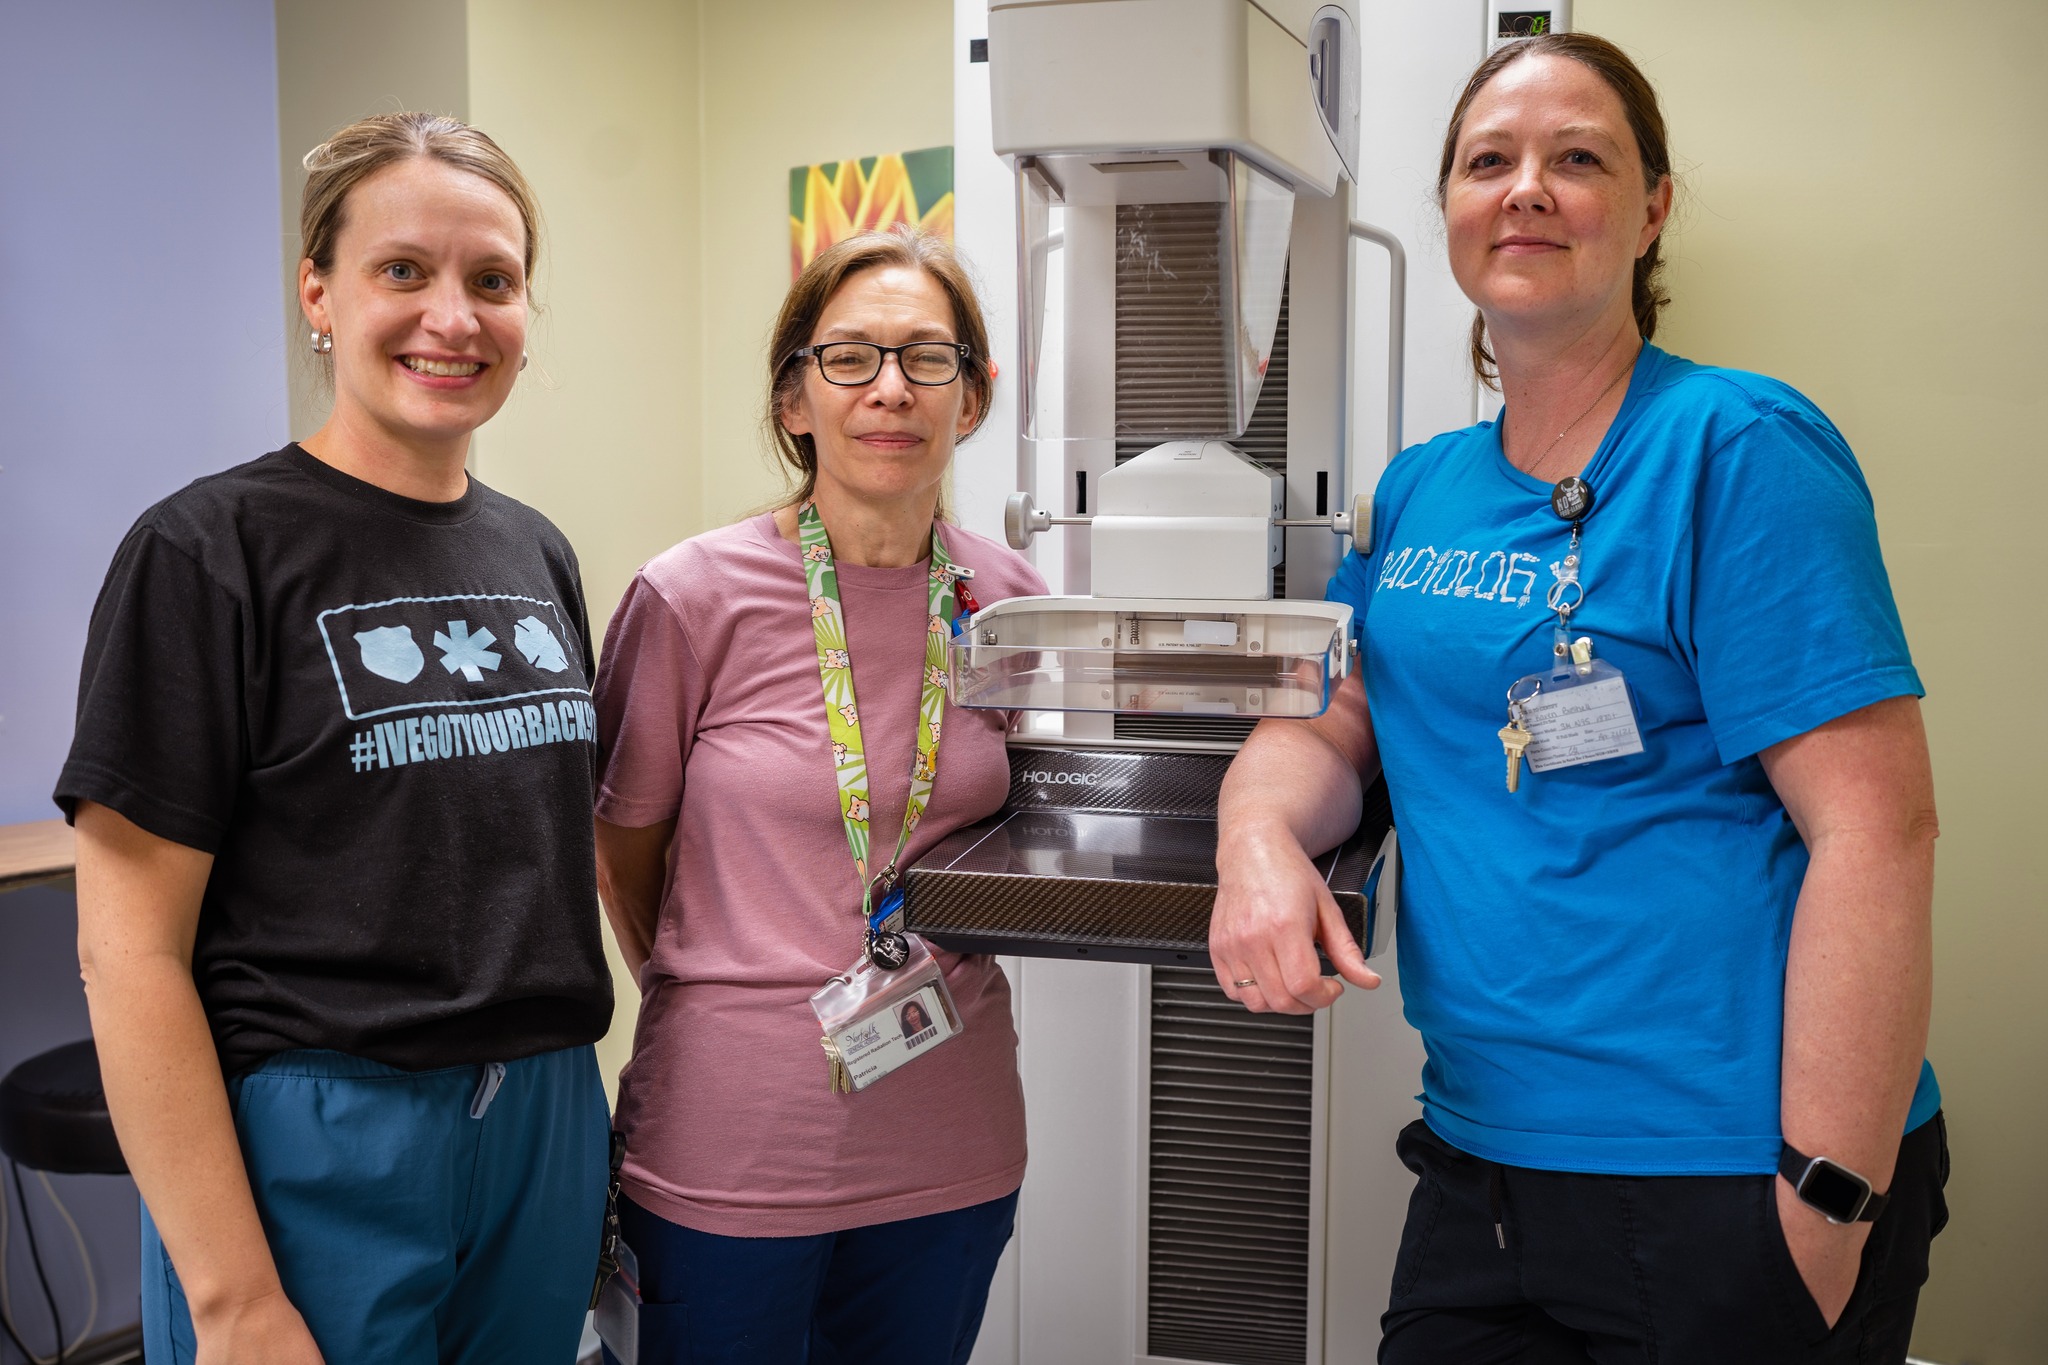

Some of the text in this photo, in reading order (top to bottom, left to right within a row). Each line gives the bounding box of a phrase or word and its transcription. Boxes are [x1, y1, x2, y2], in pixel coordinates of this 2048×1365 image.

[1022, 770, 1098, 786] HOLOGIC
[845, 1022, 880, 1048] Norfolk
[853, 1065, 878, 1081] Patricia
